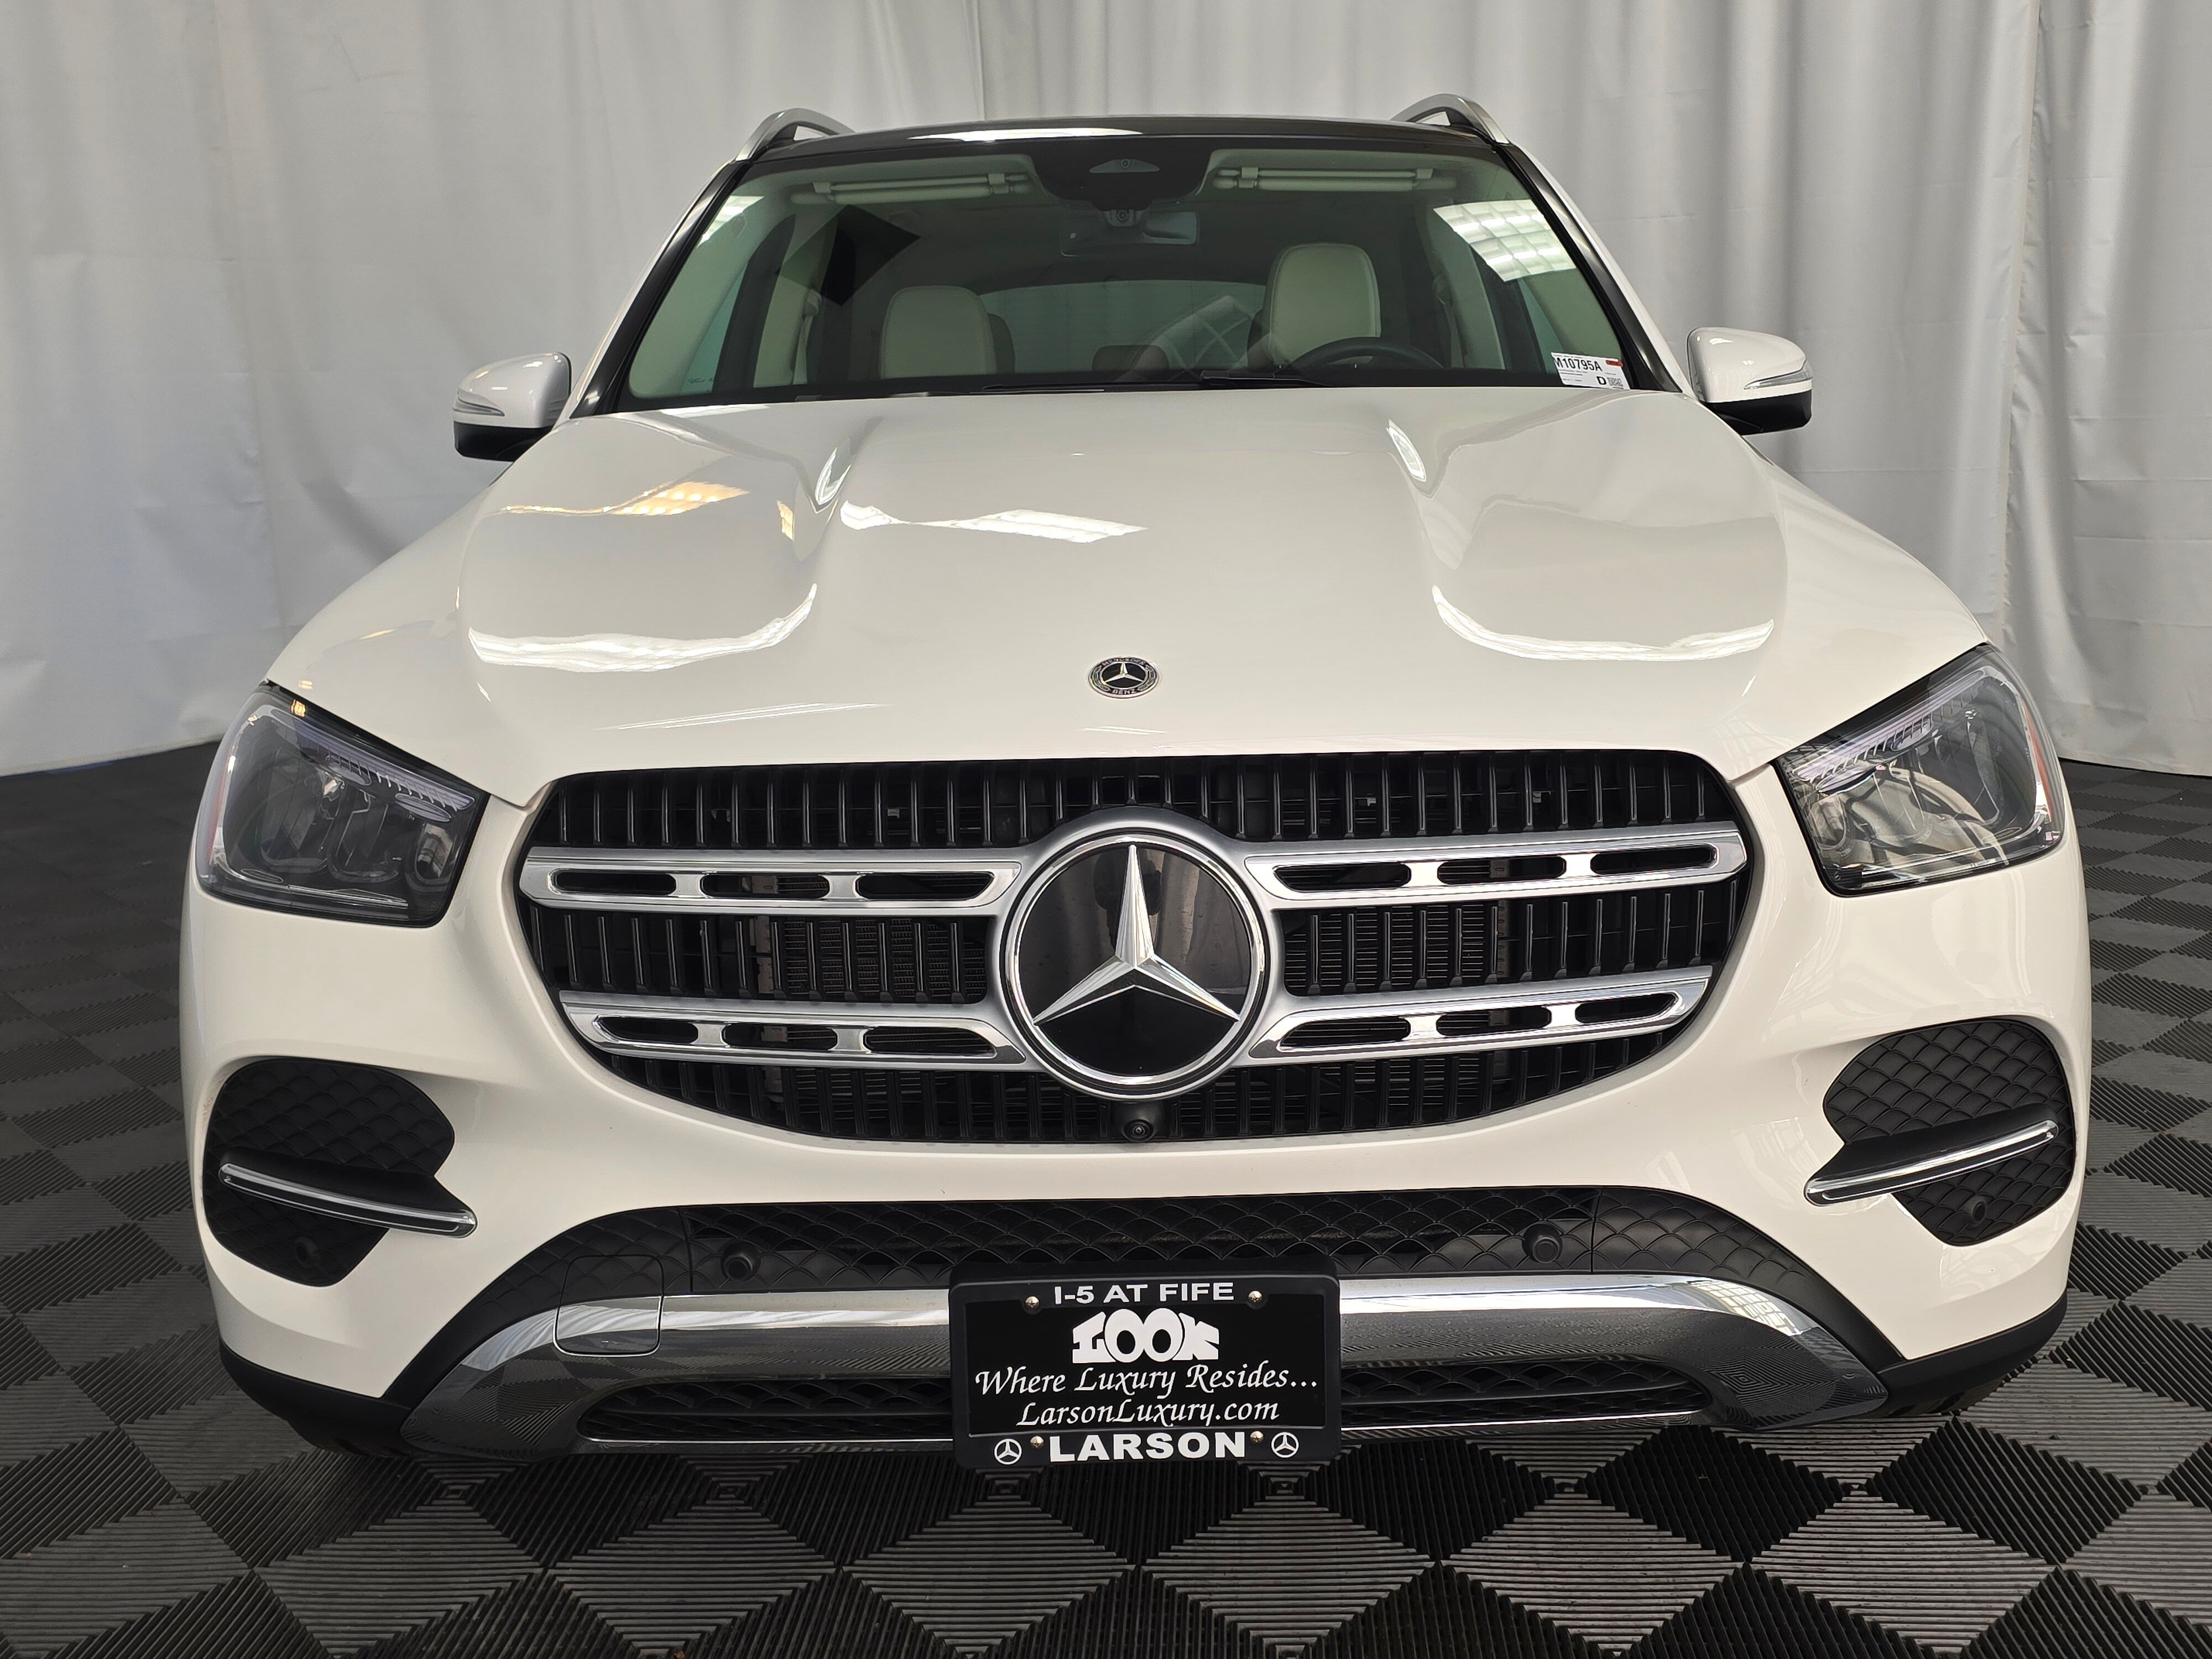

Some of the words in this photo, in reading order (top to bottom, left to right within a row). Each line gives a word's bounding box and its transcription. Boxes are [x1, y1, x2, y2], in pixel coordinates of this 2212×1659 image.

[1554, 357, 1603, 372] M10795A
[1596, 375, 1607, 385] D
[1054, 1285, 1094, 1305] I-5
[1103, 1284, 1148, 1303] AT
[1159, 1282, 1234, 1302] FIFE
[1072, 1307, 1219, 1364] LOOK
[975, 1366, 1066, 1395] Where
[1074, 1367, 1176, 1400] Luxury
[1185, 1360, 1318, 1394] Resides...
[1016, 1399, 1280, 1428] LarsonLuxury.com
[1049, 1431, 1245, 1463] LARSON
